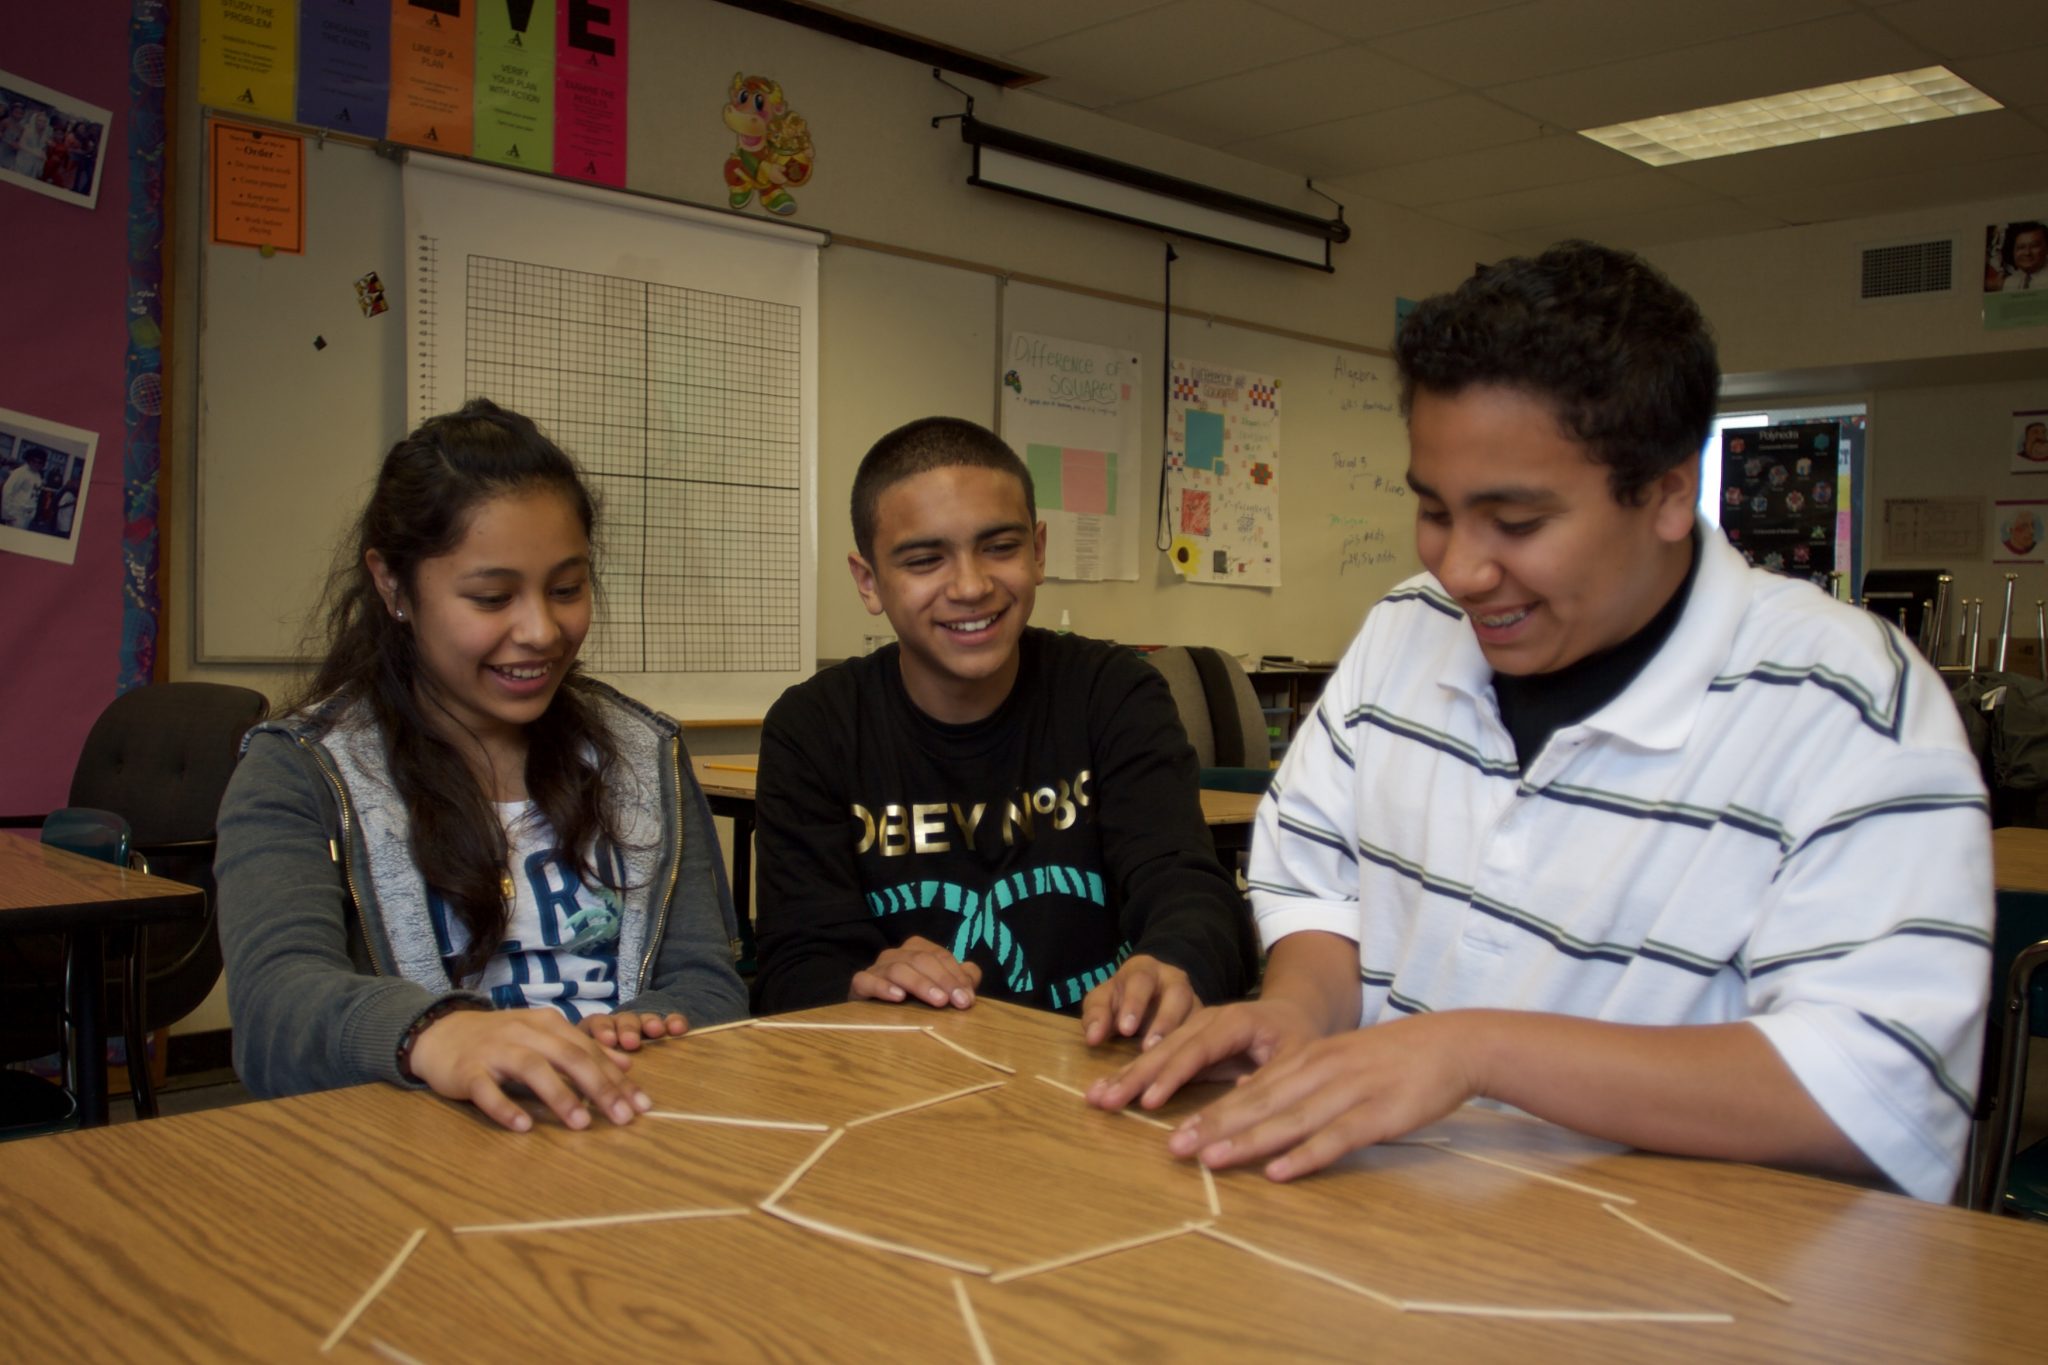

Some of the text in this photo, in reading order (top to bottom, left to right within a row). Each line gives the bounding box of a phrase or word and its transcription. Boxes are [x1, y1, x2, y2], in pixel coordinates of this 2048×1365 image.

[256, 5, 274, 17] THE
[223, 10, 272, 29] PROBLEM
[421, 56, 445, 69] PLAN
[501, 64, 528, 77] VERIFY
[492, 73, 537, 91] YOUR PLAN
[489, 85, 540, 104] WITH ACTION
[244, 146, 273, 158] Order
